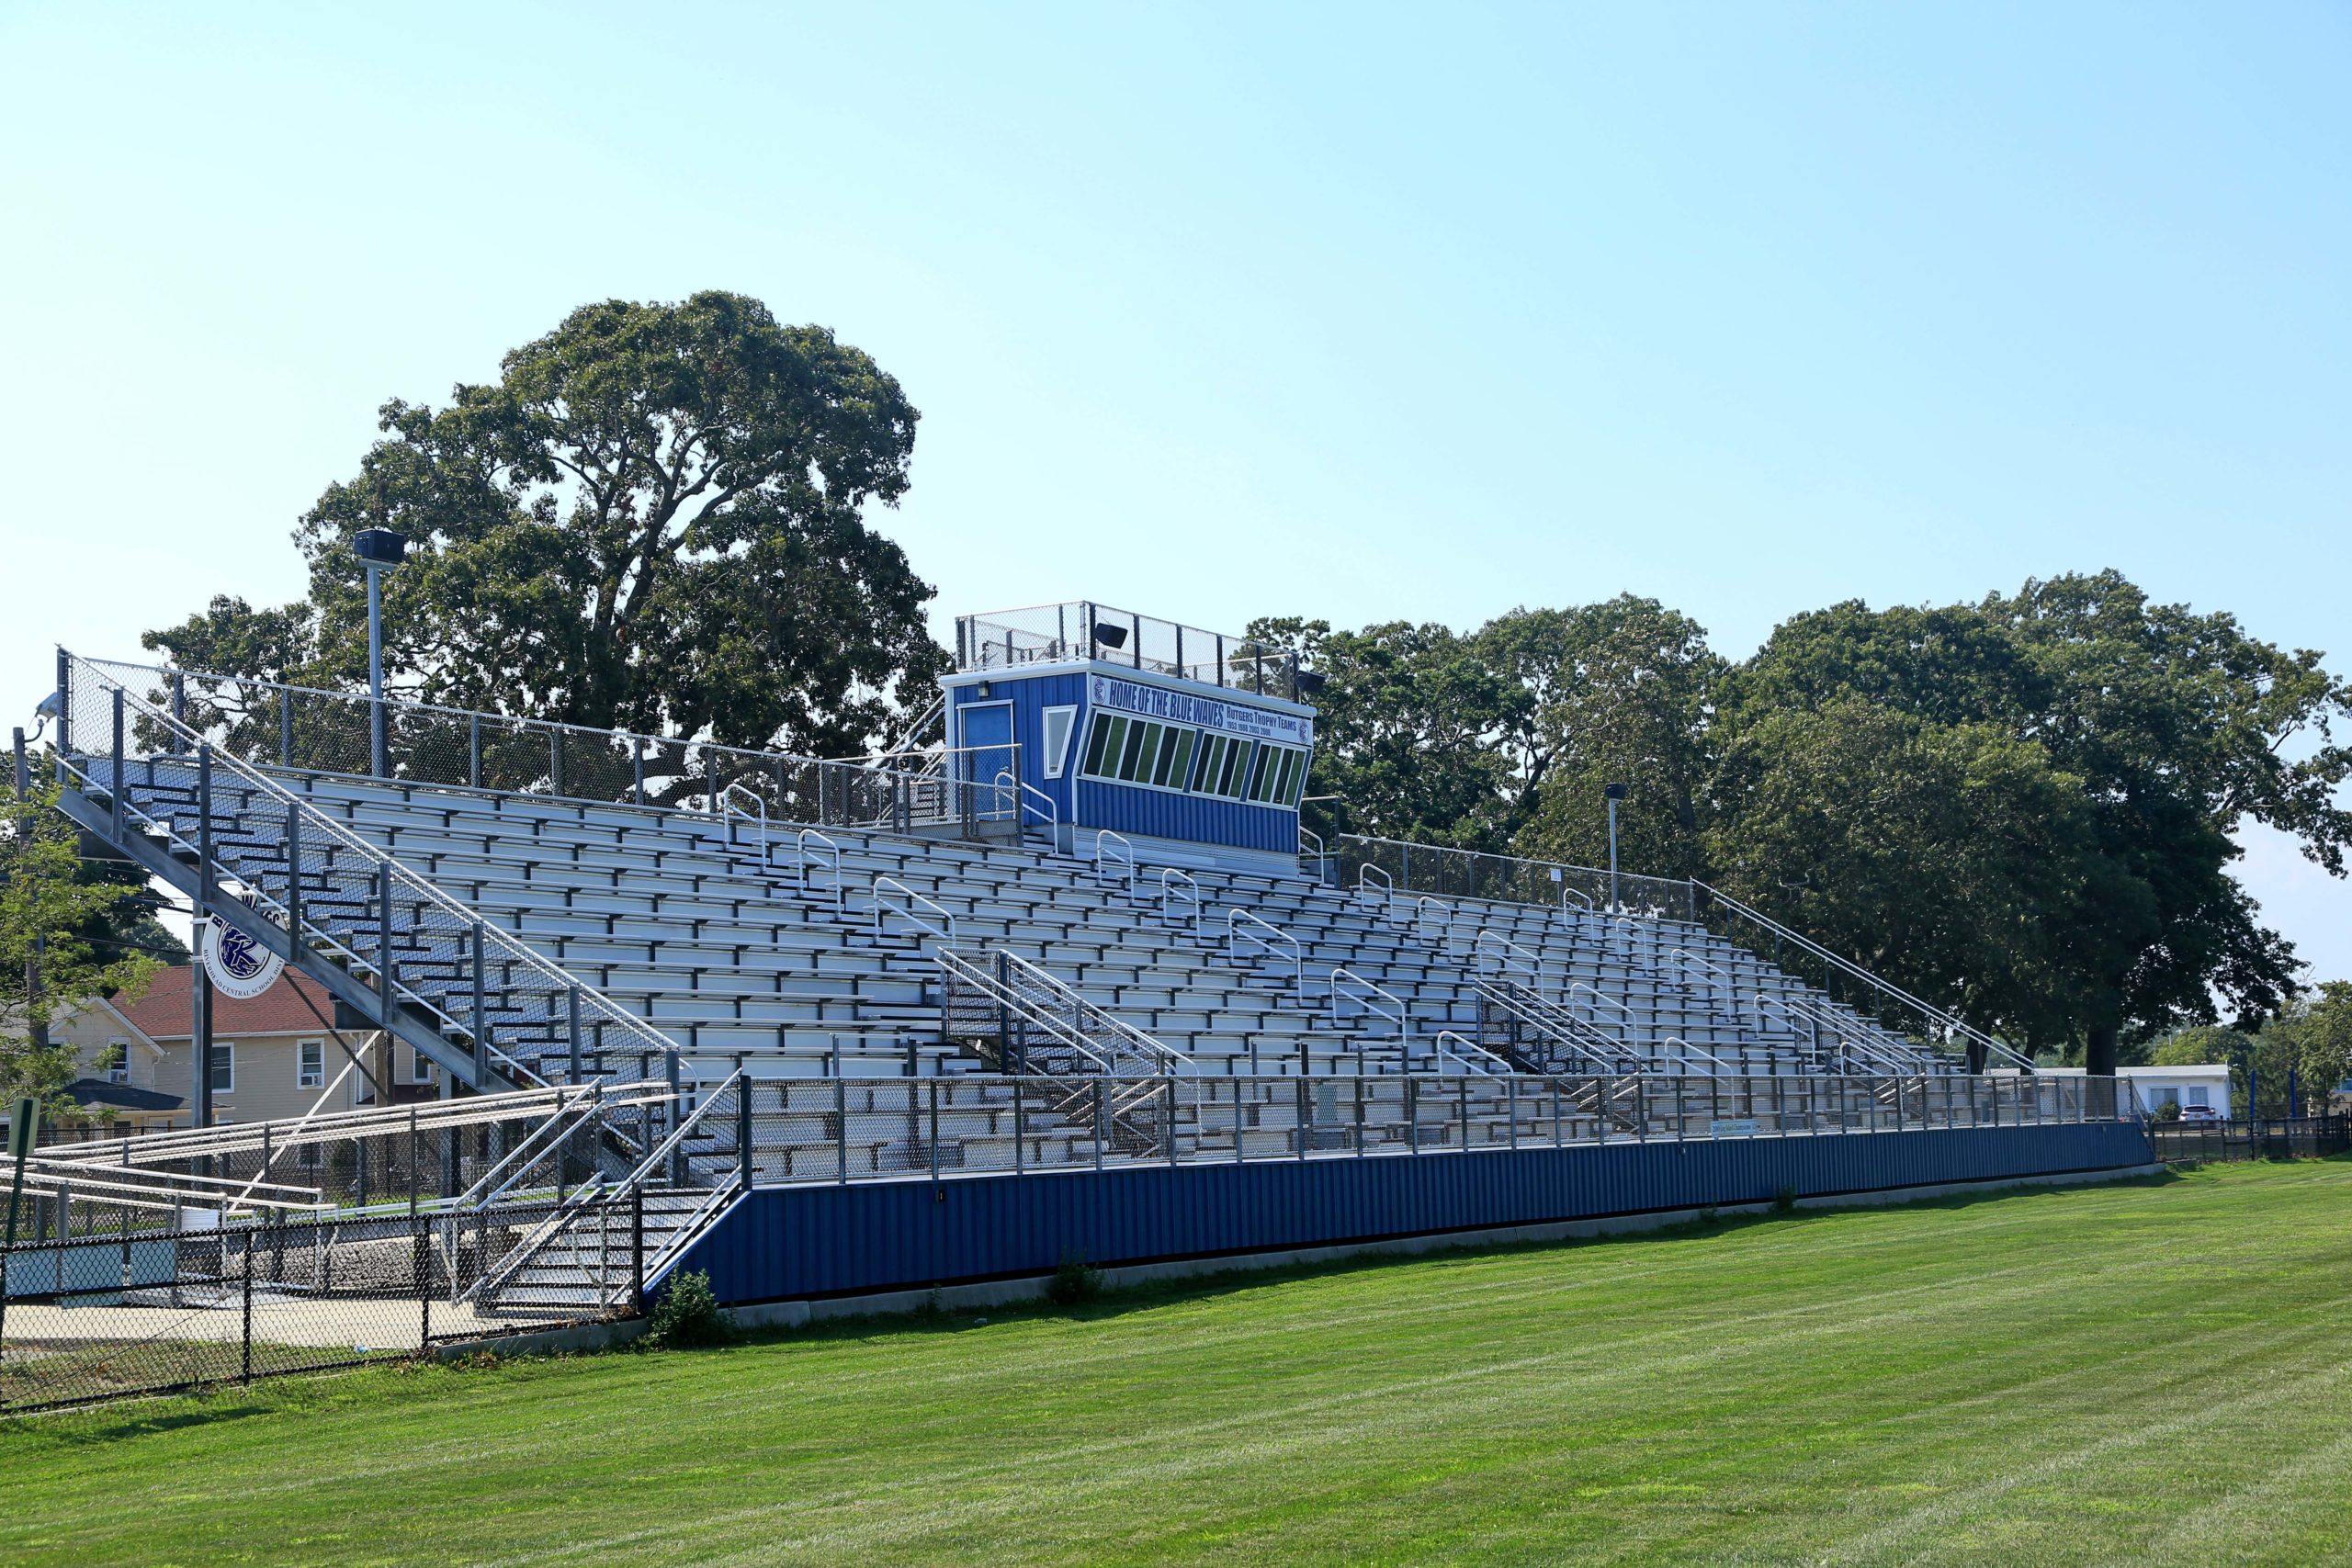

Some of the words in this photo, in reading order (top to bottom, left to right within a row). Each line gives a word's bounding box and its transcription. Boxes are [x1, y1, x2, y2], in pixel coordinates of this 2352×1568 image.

[1109, 681, 1137, 710] HOME
[1137, 687, 1150, 713] OF
[1151, 690, 1168, 716] THE
[1170, 692, 1193, 722] BLUE
[1193, 698, 1225, 728] WAVES
[1227, 705, 1254, 724] RUTGERS
[1254, 711, 1277, 728] TROPHY
[1278, 716, 1297, 732] TEAMS
[1227, 721, 1238, 730] 1953
[203, 949, 223, 988] RIVERHEAD
[222, 985, 251, 998] CENTRAL
[252, 976, 276, 995] SCHOOL
